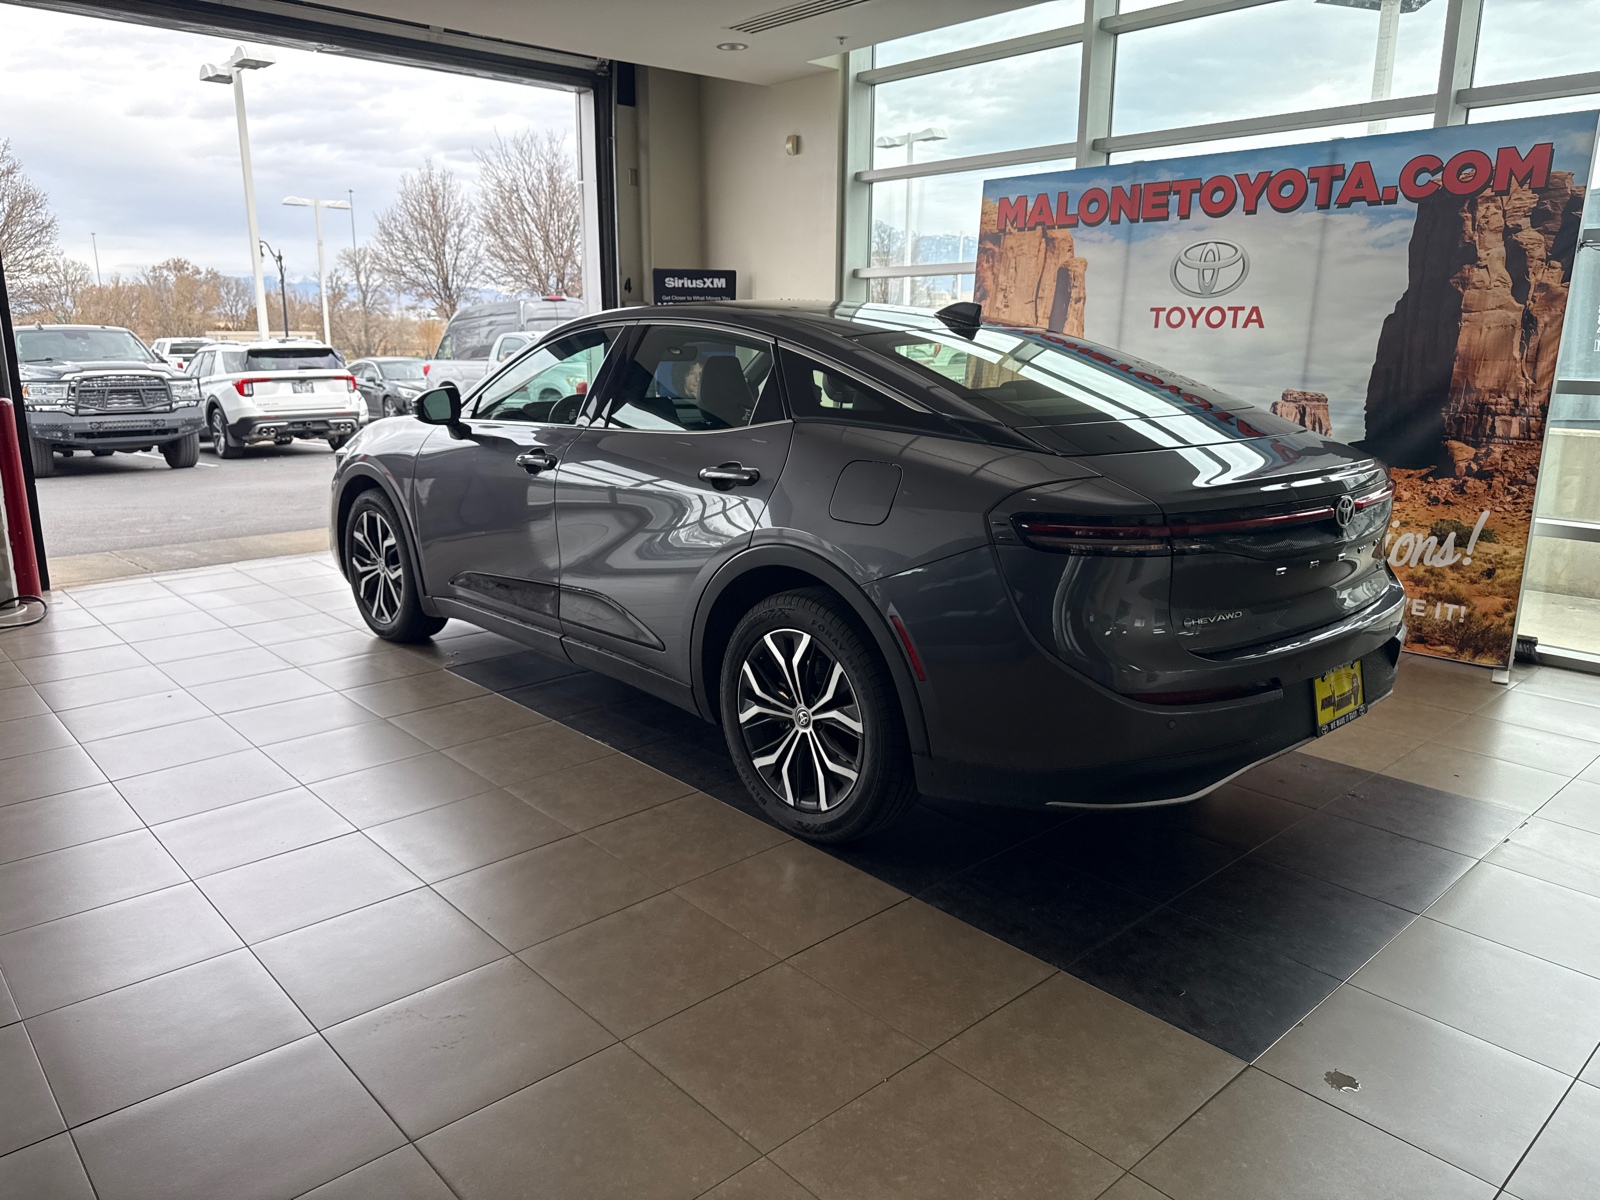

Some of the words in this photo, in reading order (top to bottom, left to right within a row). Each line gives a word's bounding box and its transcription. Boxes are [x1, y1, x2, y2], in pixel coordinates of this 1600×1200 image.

[996, 142, 1555, 233] MALONETOYOTA.COM
[664, 277, 726, 288] SiriusXM
[1150, 305, 1265, 329] TOYOTA
[1434, 602, 1467, 623] IT!
[810, 619, 846, 652] FORAY
